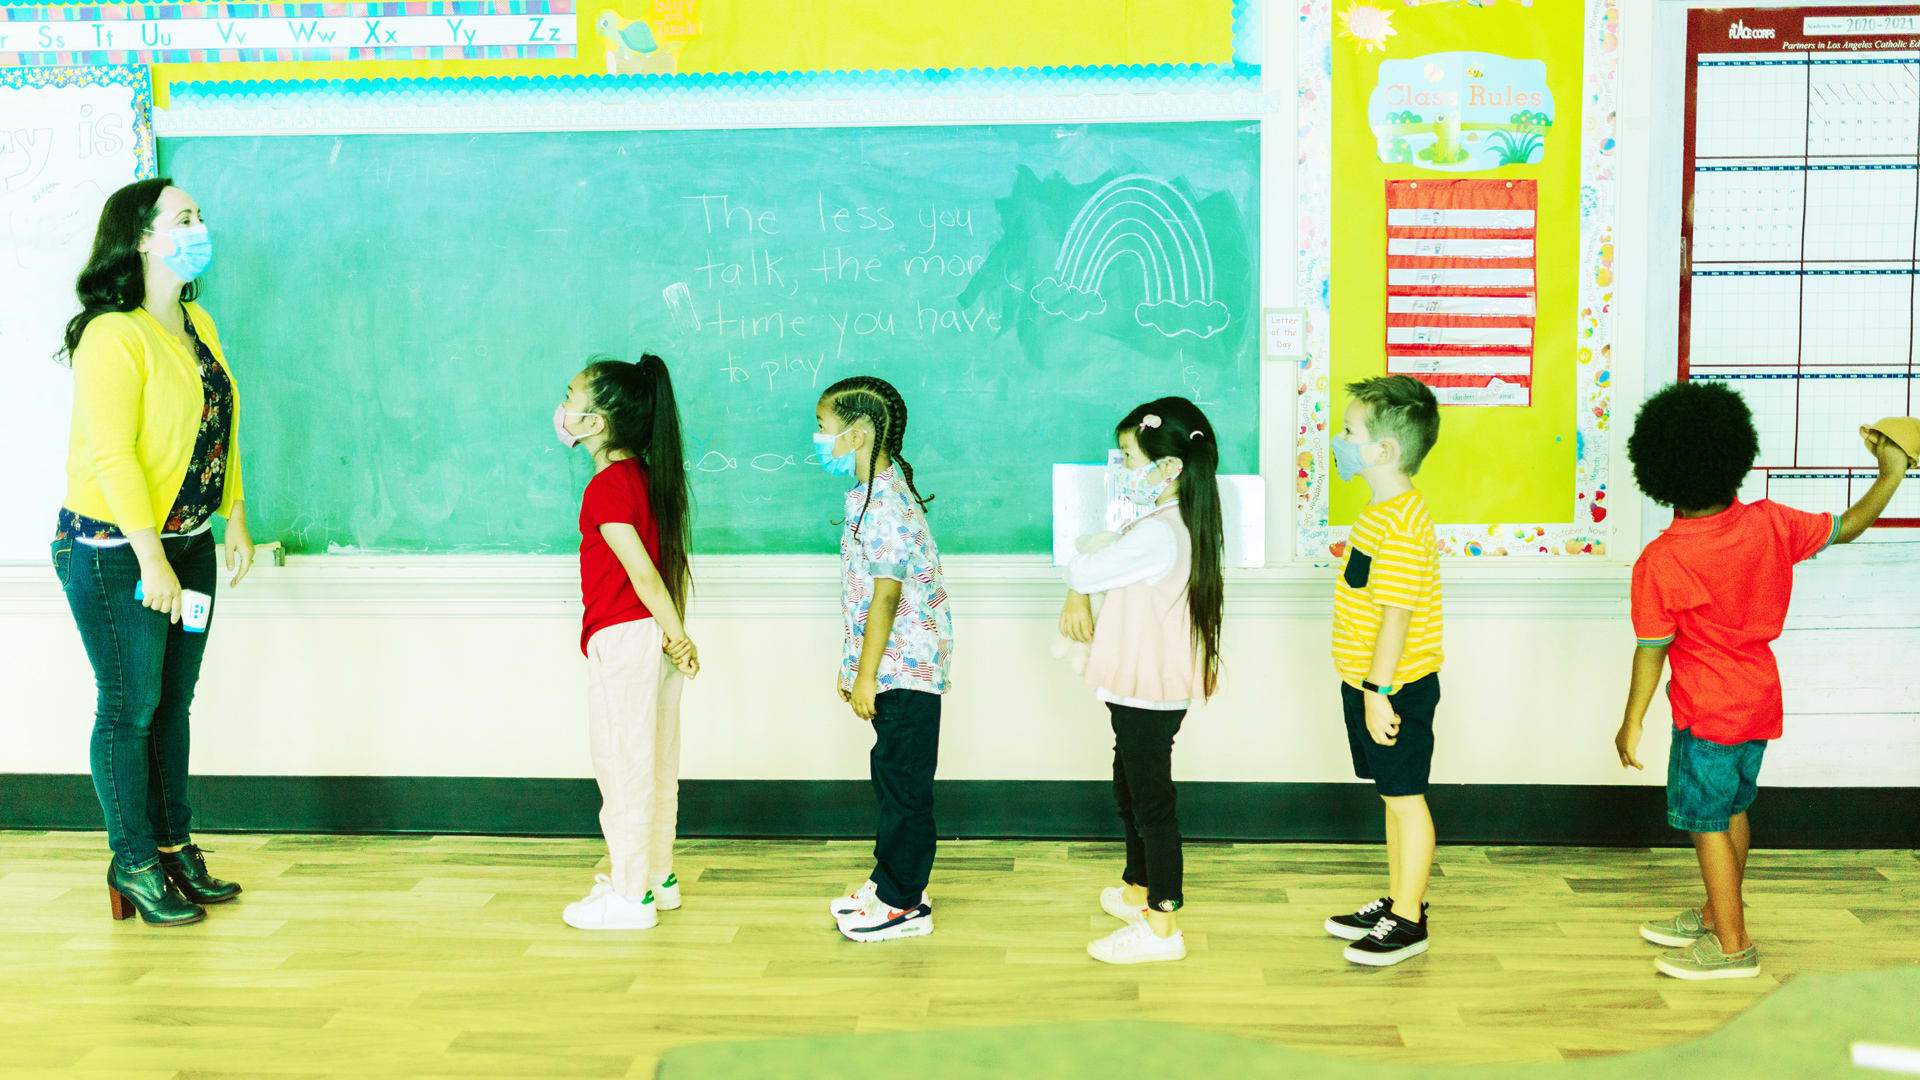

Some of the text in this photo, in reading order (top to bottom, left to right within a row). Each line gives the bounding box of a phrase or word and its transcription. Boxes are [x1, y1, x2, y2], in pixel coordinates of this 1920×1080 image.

[665, 12, 684, 21] on
[654, 20, 697, 35] Task
[1752, 28, 1776, 39] CORPS
[1782, 41, 1816, 49] Partners
[1818, 40, 1826, 48] in
[1827, 41, 1841, 49] Los
[1842, 40, 1873, 50] Angeles
[1874, 39, 1907, 49] Catholic
[1384, 85, 1543, 106] Class Rules
[79, 103, 123, 157] is
[680, 190, 974, 254] The less you
[810, 248, 884, 284] the
[706, 299, 1002, 358] time you have
[1271, 316, 1298, 325] Letter
[1271, 327, 1298, 337] of the
[1275, 340, 1292, 351] Day
[720, 352, 824, 392] to play
[1312, 437, 1326, 469] October
[1310, 473, 1325, 511] November
